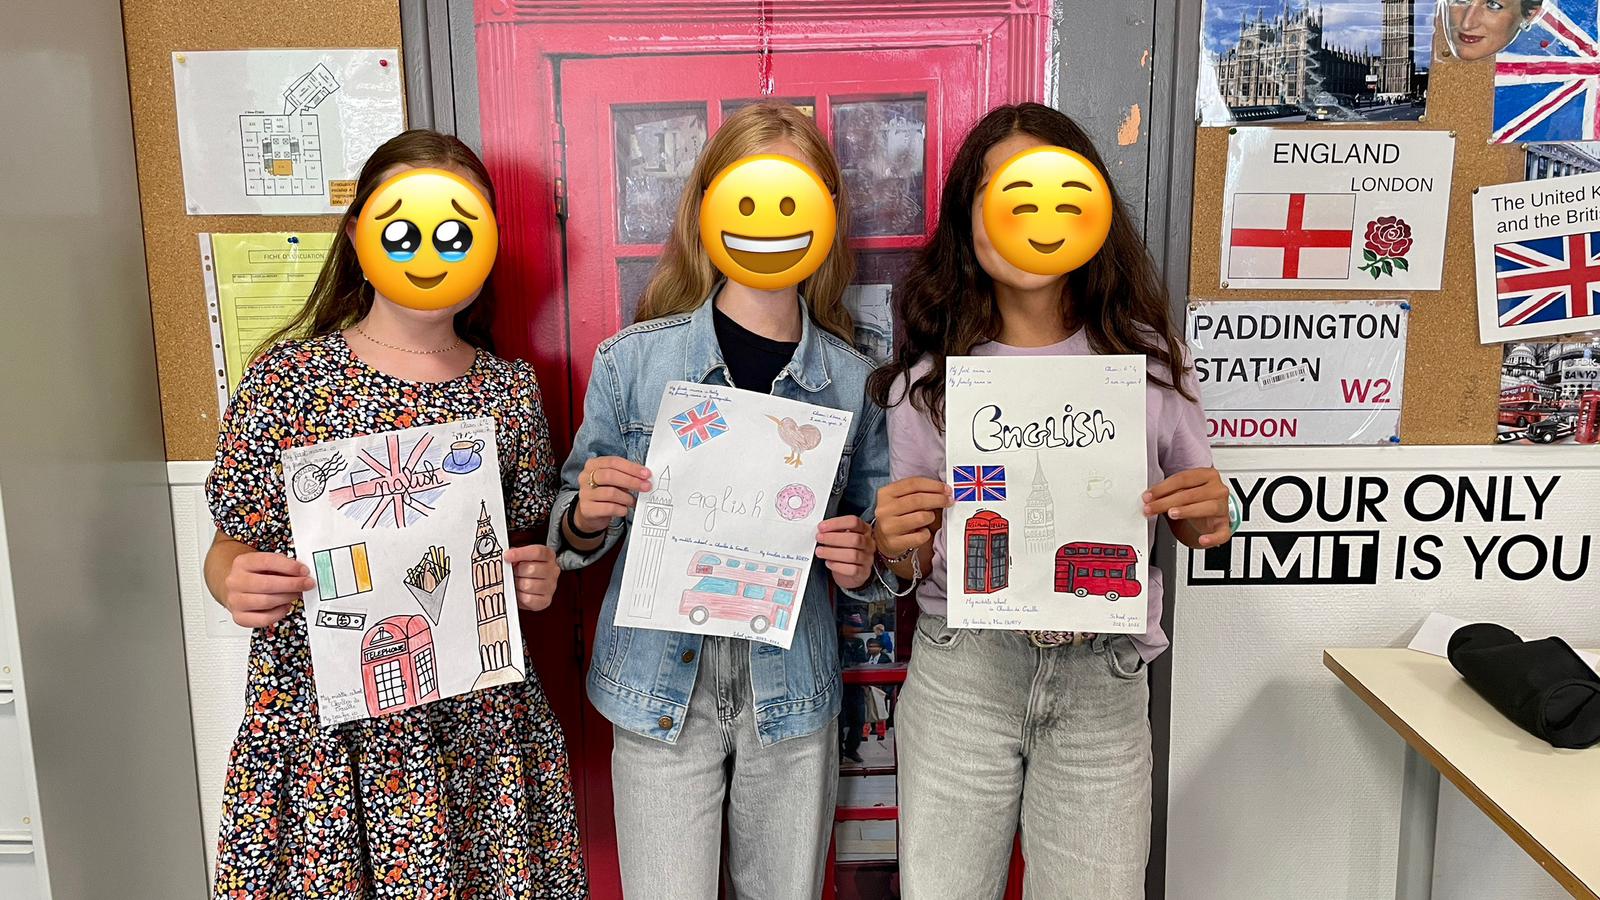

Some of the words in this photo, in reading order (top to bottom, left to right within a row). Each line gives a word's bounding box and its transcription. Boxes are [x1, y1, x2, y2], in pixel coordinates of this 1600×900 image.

[1273, 143, 1400, 164] ENGLAND
[1351, 177, 1433, 192] LONDON
[1491, 196, 1525, 212] The
[1531, 186, 1585, 207] United
[1497, 215, 1528, 233] and
[1534, 213, 1560, 229] the
[1567, 206, 1600, 224] Briti
[1194, 314, 1400, 340] PADDINGTON
[1341, 378, 1391, 404] W2
[1206, 418, 1297, 438] ONDON
[687, 486, 765, 533] english
[1228, 475, 1389, 524] YOUR
[1403, 474, 1562, 523] ONLY
[1190, 535, 1375, 580] LIMIT
[1395, 534, 1445, 581] IS
[1463, 534, 1592, 582] YOU
[365, 645, 404, 660] TELEPHONE
